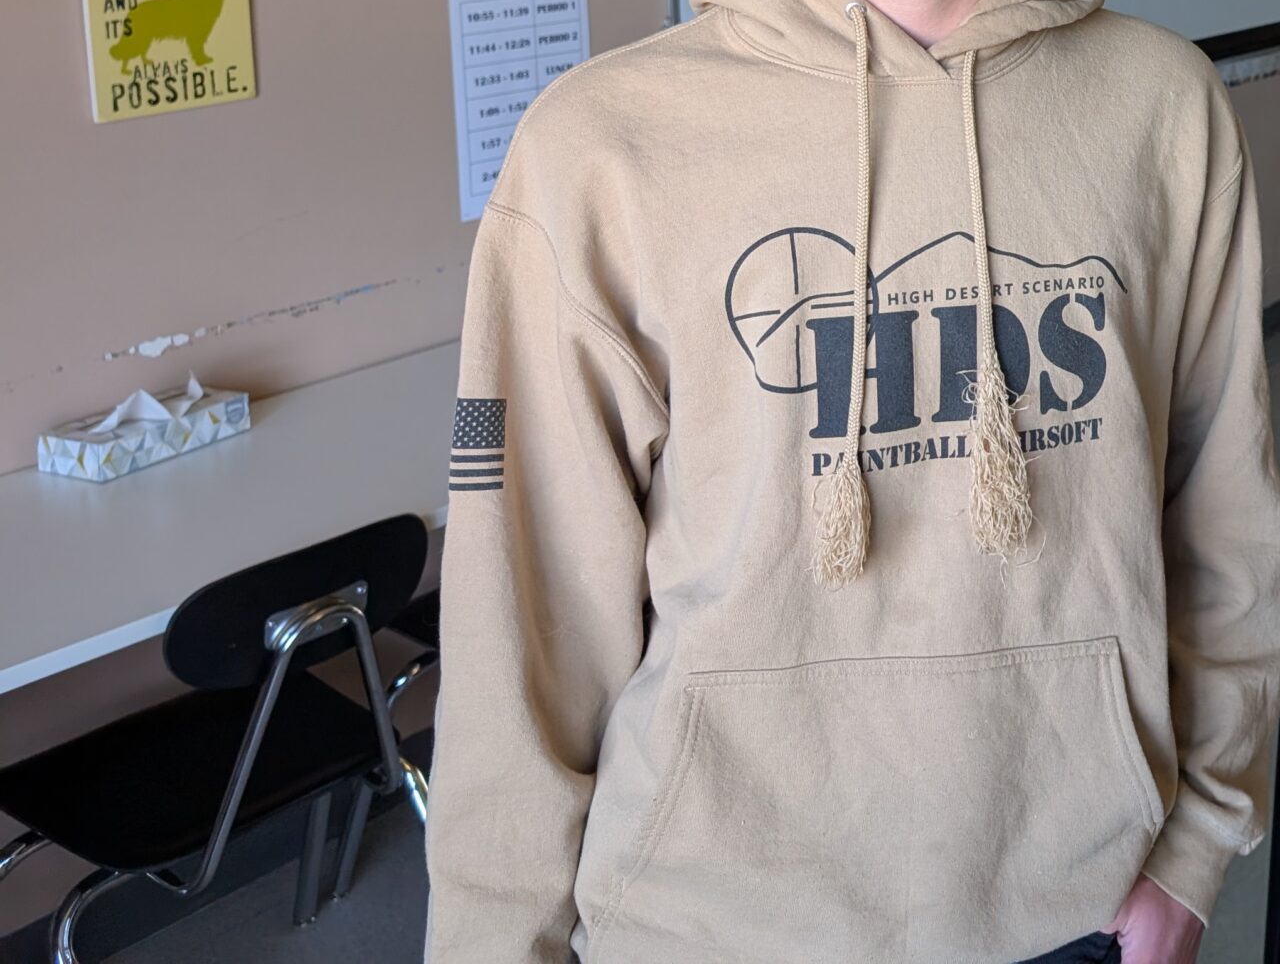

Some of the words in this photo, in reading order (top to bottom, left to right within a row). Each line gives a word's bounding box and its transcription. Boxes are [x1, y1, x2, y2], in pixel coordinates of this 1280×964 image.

[537, 2, 568, 14] PERIOD
[105, 18, 133, 39] IT'S
[538, 32, 570, 45] PERIOD
[469, 43, 496, 55] 11:44
[133, 58, 189, 80] ALWAYS
[112, 66, 248, 112] POSSIBLE.
[887, 289, 935, 306] HIGH
[945, 284, 1014, 301] DESRT
[1022, 275, 1106, 295] SCENARIO
[805, 291, 1107, 439] HDS
[1018, 418, 1103, 454] IRSOFT
